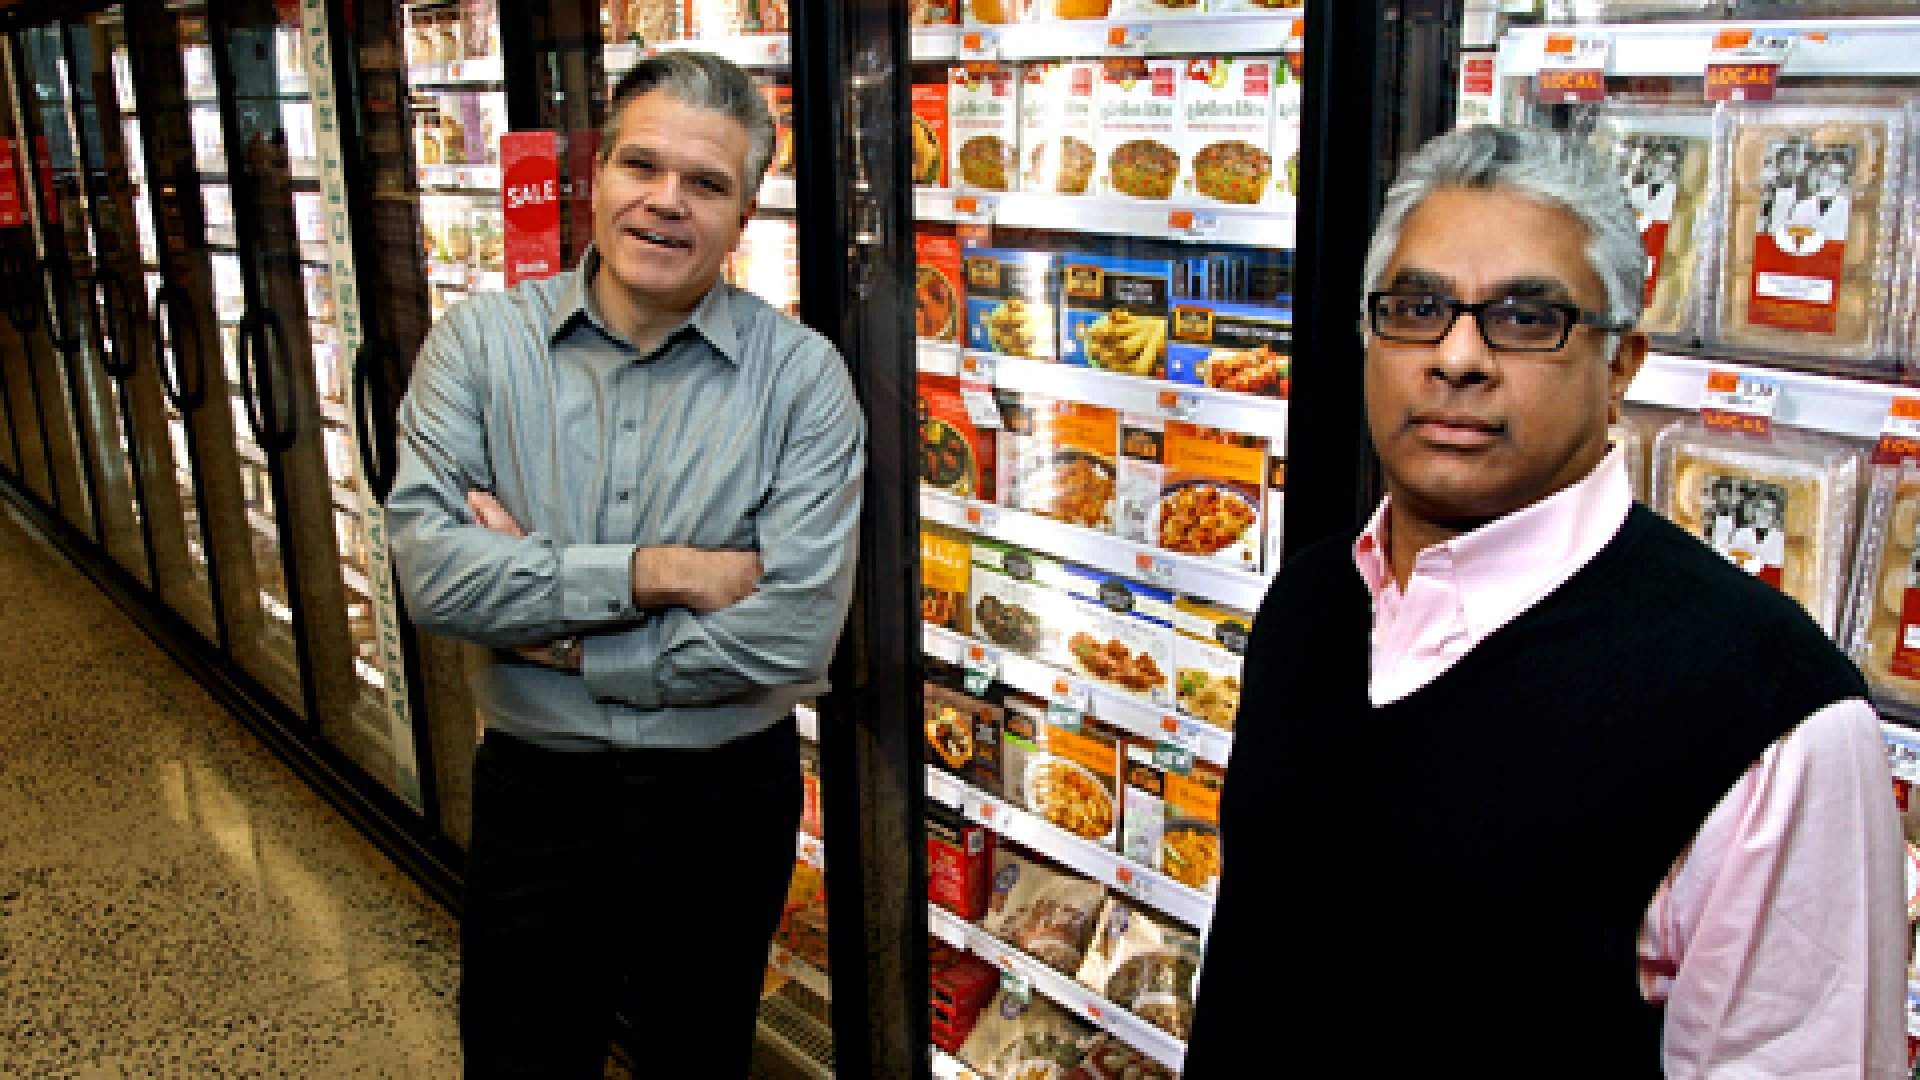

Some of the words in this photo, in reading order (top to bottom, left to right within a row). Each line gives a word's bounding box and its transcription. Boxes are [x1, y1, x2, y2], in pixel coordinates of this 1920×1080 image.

[1540, 72, 1598, 90] LOCAL
[1708, 66, 1770, 86] LOCAL
[507, 179, 557, 209] SALE
[1703, 411, 1765, 433] LOCAL
[1882, 434, 1920, 455] LOC
